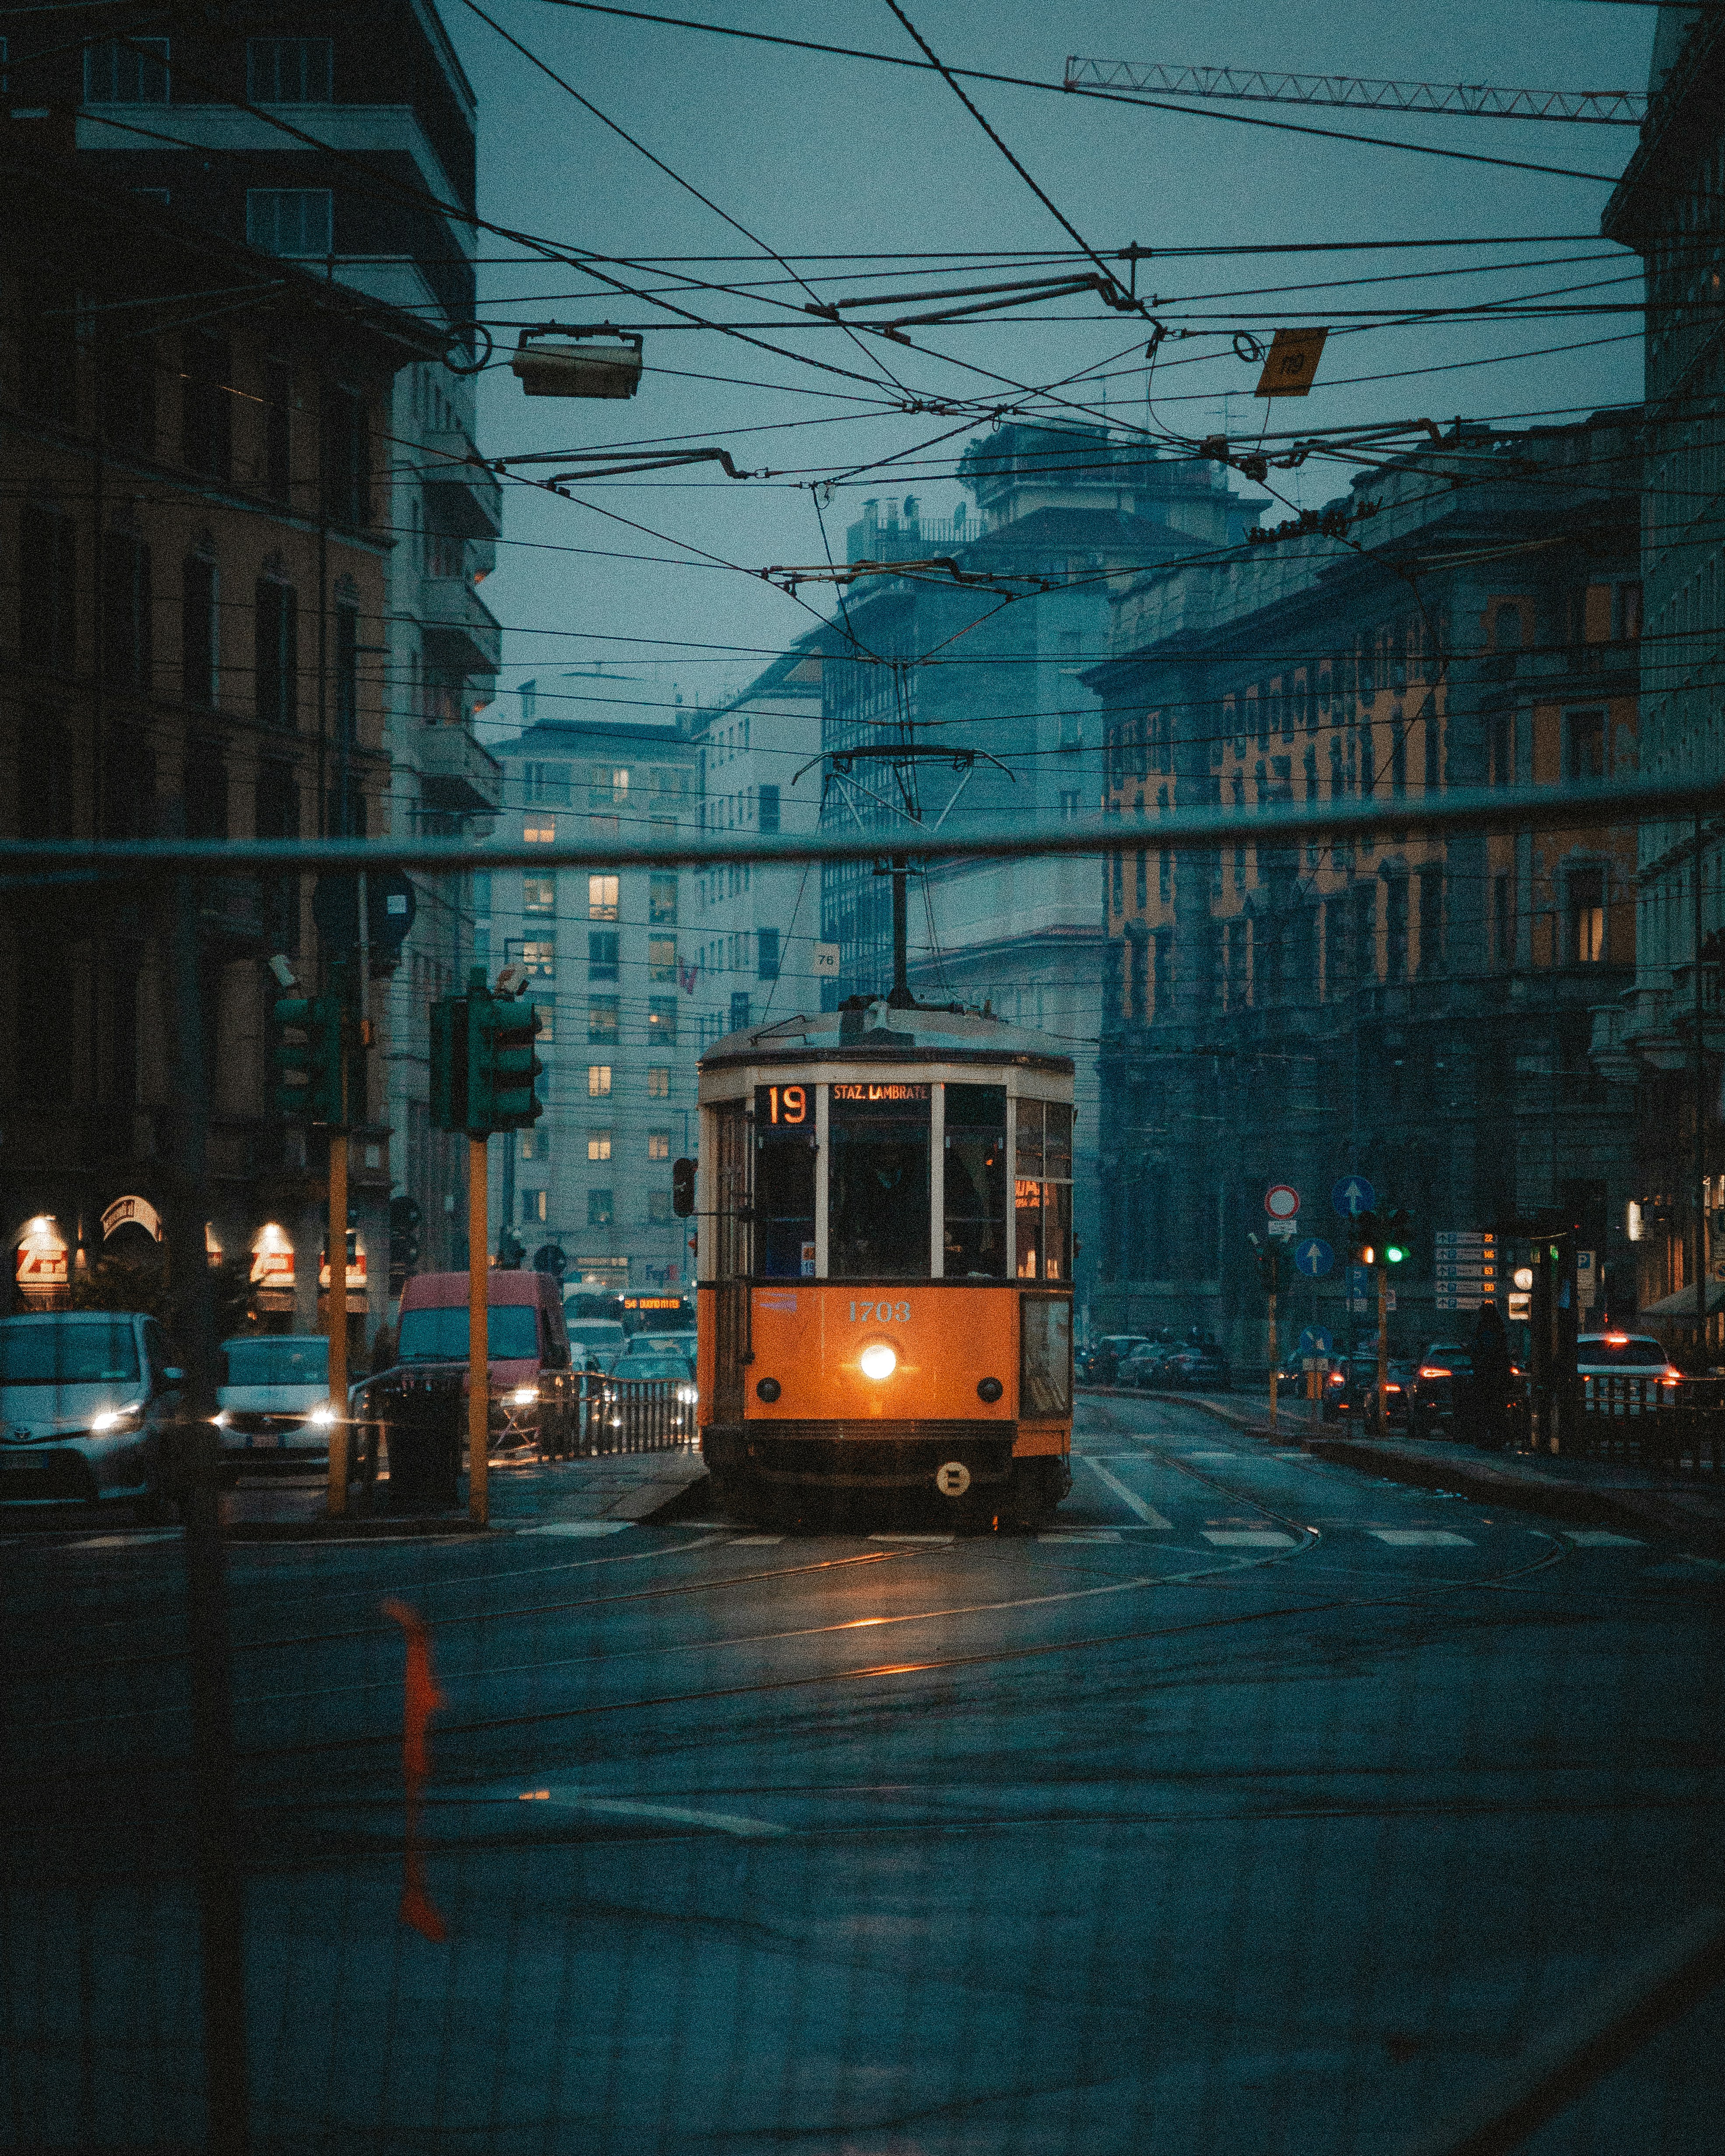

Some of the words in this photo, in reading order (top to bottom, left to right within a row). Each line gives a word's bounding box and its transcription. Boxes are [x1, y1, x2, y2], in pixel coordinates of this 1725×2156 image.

[818, 955, 834, 965] 76
[834, 1084, 866, 1100] STAZ.
[868, 1084, 928, 1100] LAMBRATE
[769, 1086, 806, 1124] 19
[1484, 1234, 1493, 1242] 22
[1577, 1255, 1588, 1267] P
[1484, 1266, 1494, 1275] 63
[624, 1298, 637, 1309] 54
[849, 1301, 912, 1322] 1703
